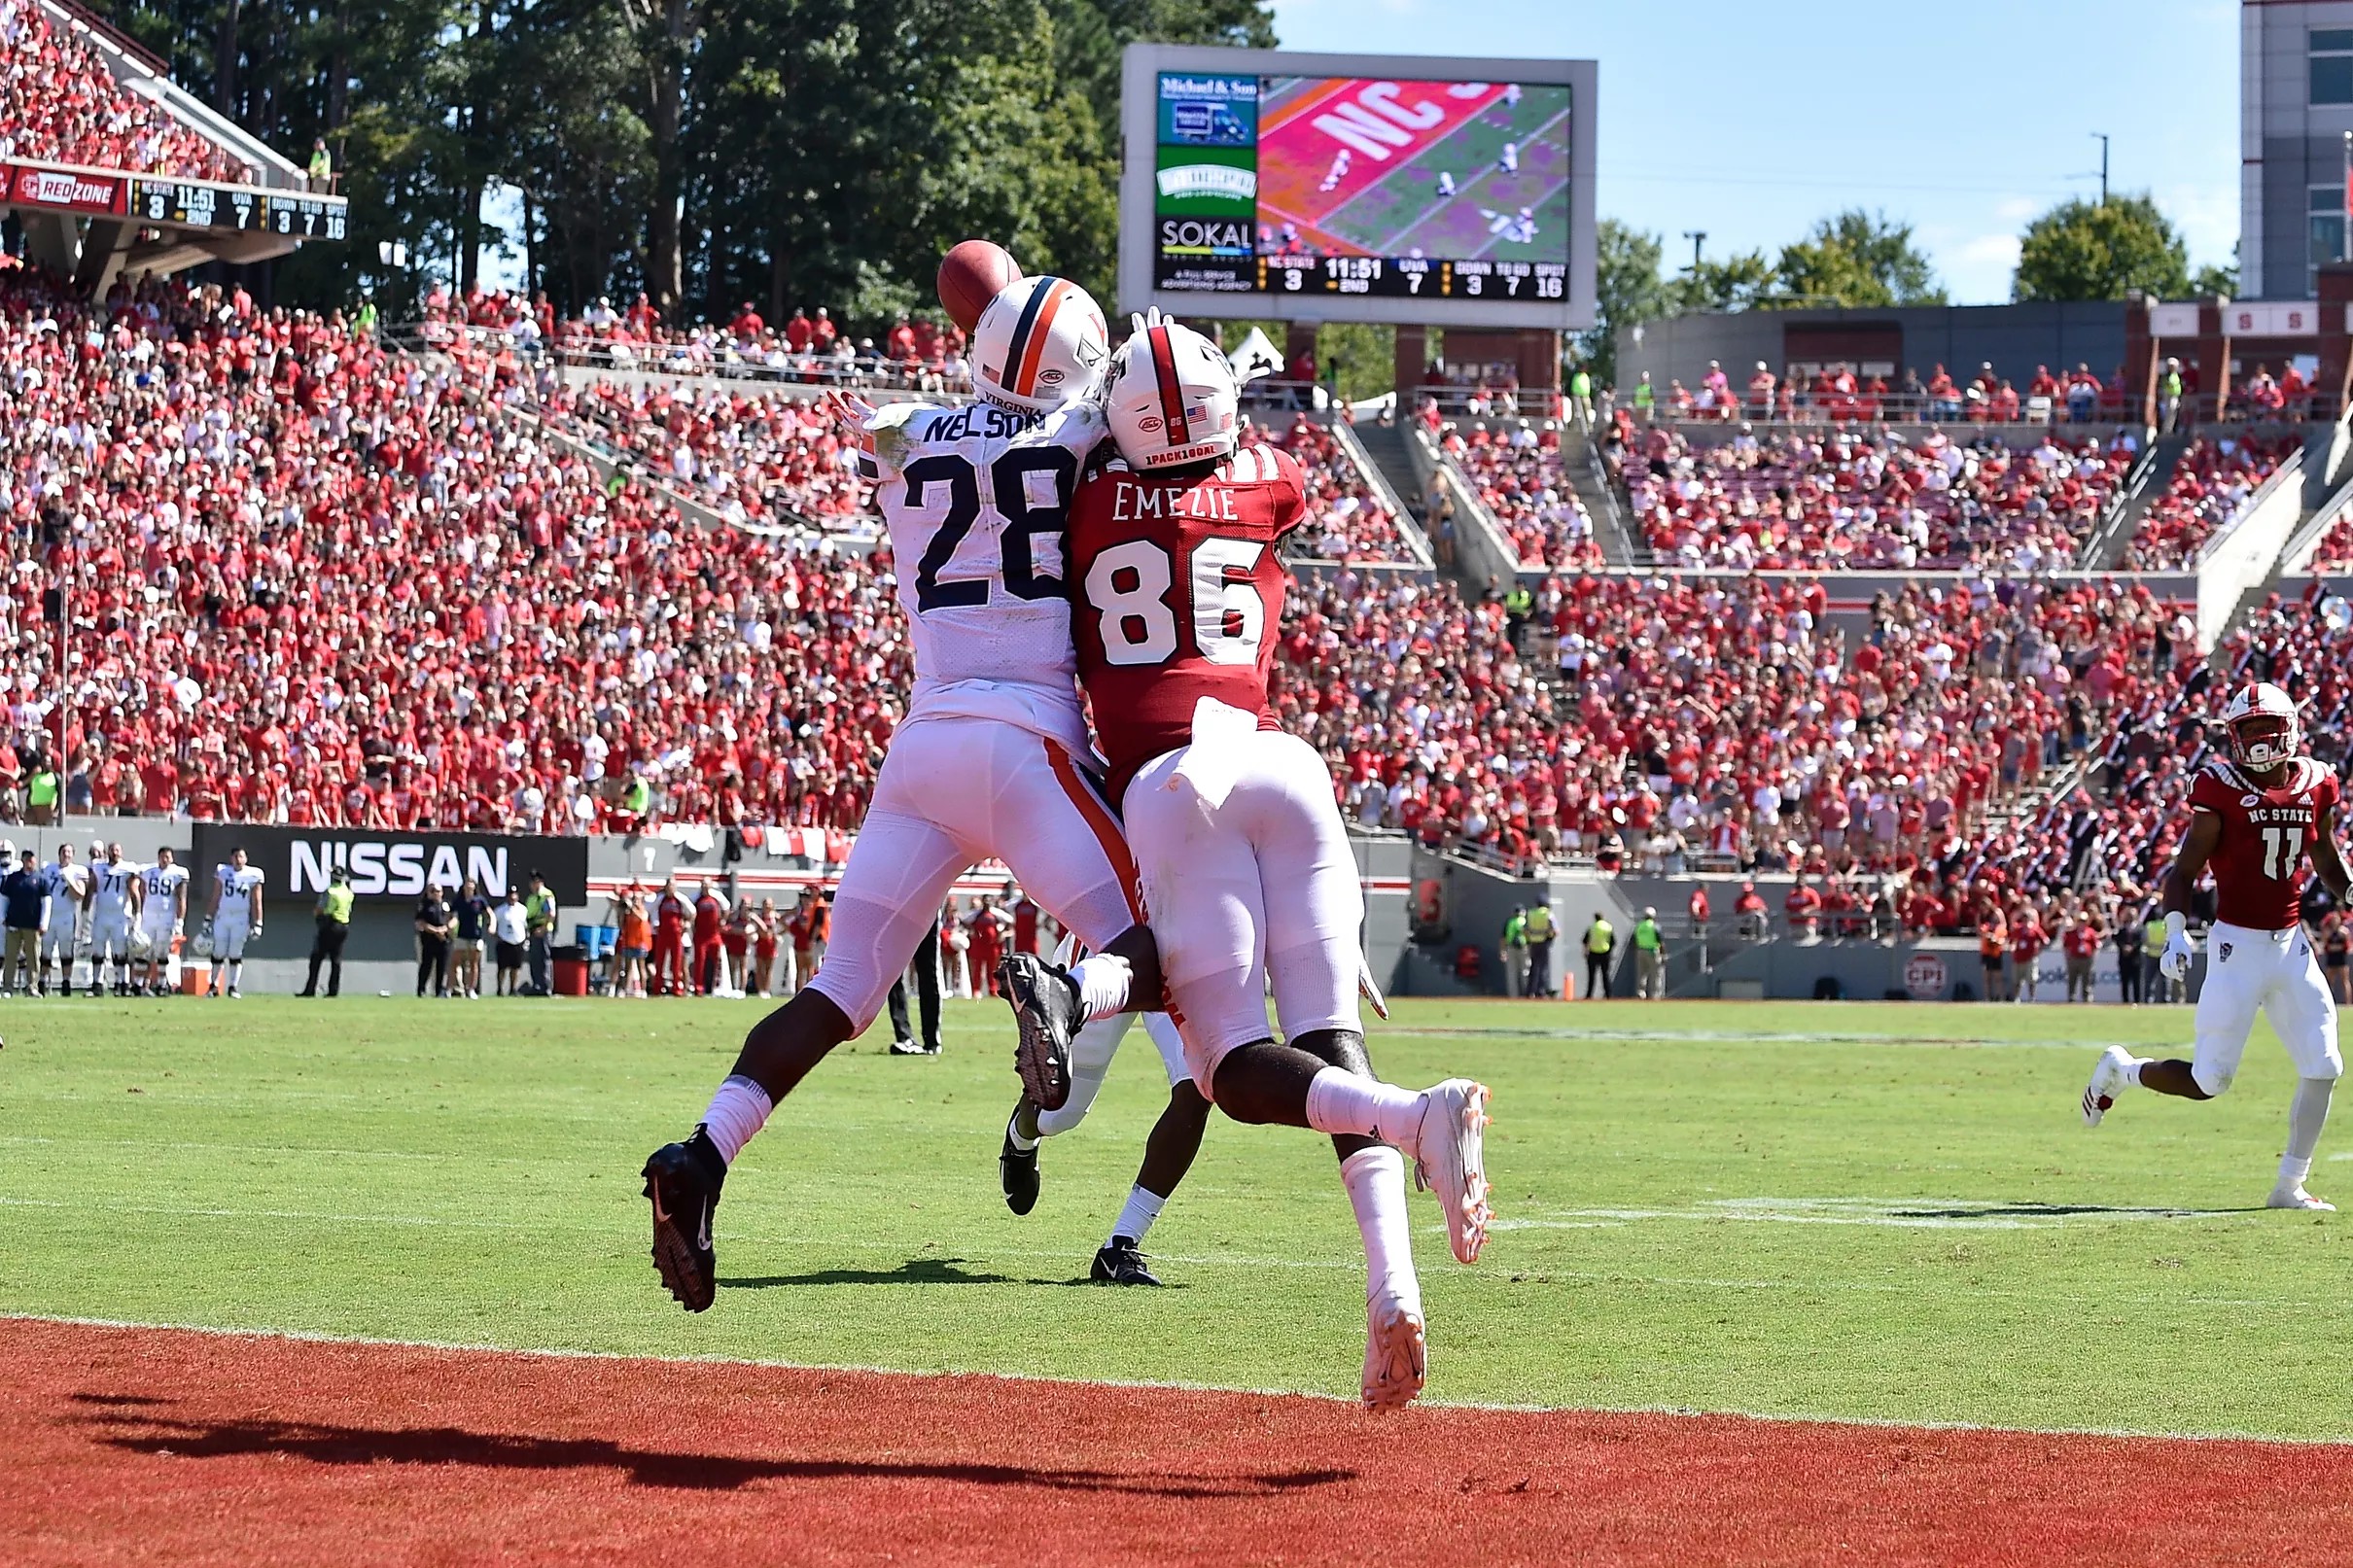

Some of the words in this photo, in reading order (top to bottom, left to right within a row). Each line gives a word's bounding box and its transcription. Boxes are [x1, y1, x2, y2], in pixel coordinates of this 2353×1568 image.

[177, 186, 216, 211] 11:51
[231, 192, 252, 206] UVA
[235, 206, 250, 229] 7
[278, 211, 291, 233] 3
[303, 214, 315, 236] 7
[1162, 220, 1252, 248] SOKAL
[1267, 256, 1282, 268] NC
[1283, 257, 1315, 269] STATE
[1325, 258, 1382, 279] 11:51
[1398, 260, 1428, 273] UVA
[1455, 261, 1492, 275] DOWN
[1533, 262, 1565, 277] SPOT
[1284, 269, 1302, 291] 3
[1406, 273, 1422, 294] 7
[1466, 275, 1482, 295] 3
[1505, 276, 1520, 296] 7
[1339, 279, 1369, 293] 2ND
[984, 391, 1042, 416] VIRGINIA
[923, 403, 1045, 442] NELSON
[1170, 417, 1182, 427] 86
[1112, 482, 1239, 522] EMEZIE
[901, 444, 1079, 613] 28
[1085, 538, 1267, 666] 86
[2248, 810, 2268, 823] NC
[2272, 809, 2313, 823] STATE
[2262, 827, 2303, 881] 11
[291, 840, 508, 897] NISSAN
[149, 877, 172, 895] 69
[1908, 968, 1942, 981] CPI
